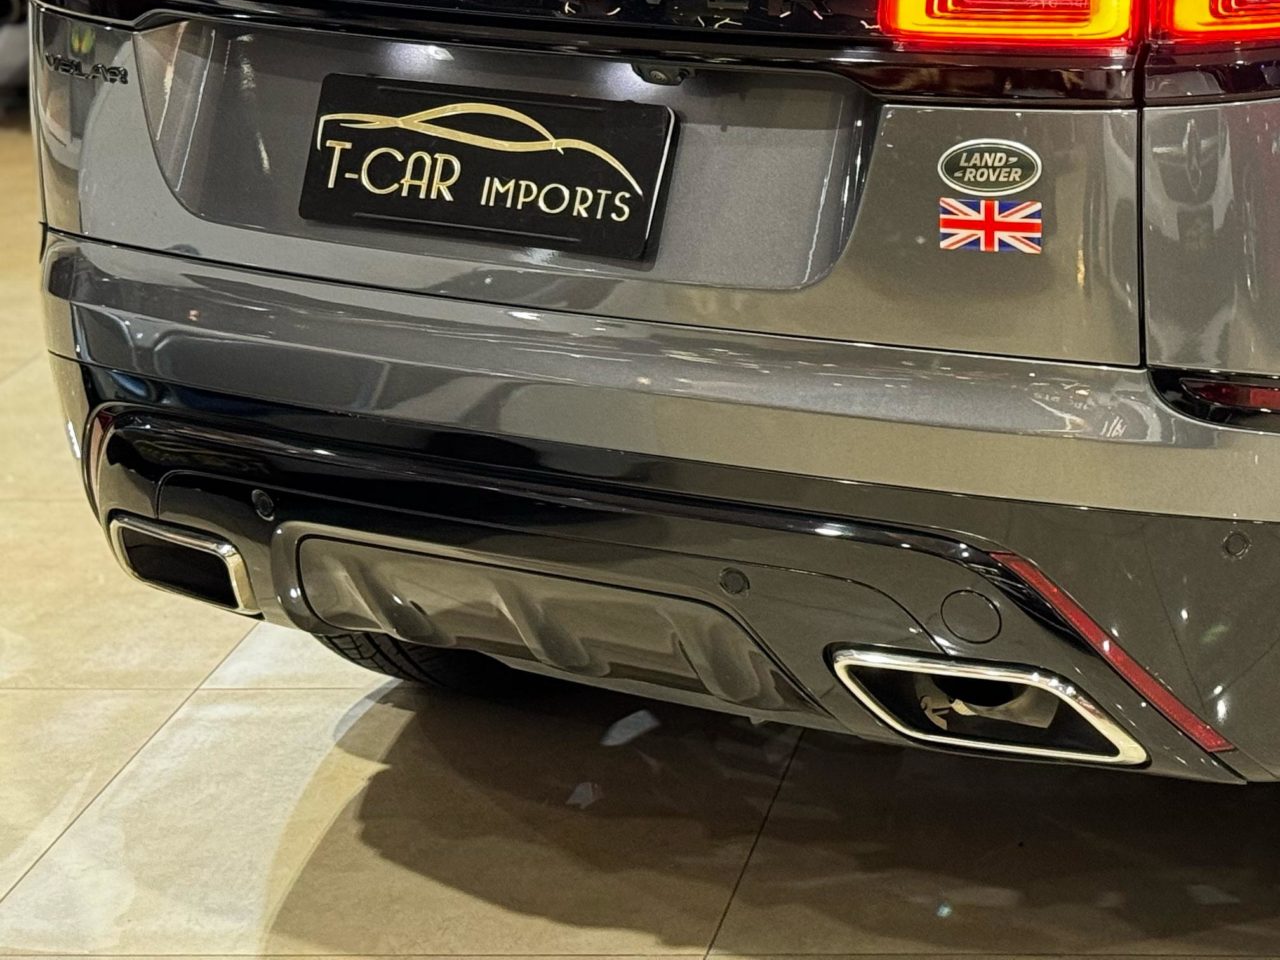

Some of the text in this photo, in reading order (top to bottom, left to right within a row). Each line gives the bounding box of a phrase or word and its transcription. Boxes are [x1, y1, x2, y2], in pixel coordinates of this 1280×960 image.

[45, 52, 129, 85] VELAR
[326, 139, 632, 223] T-CAR IMPORTS
